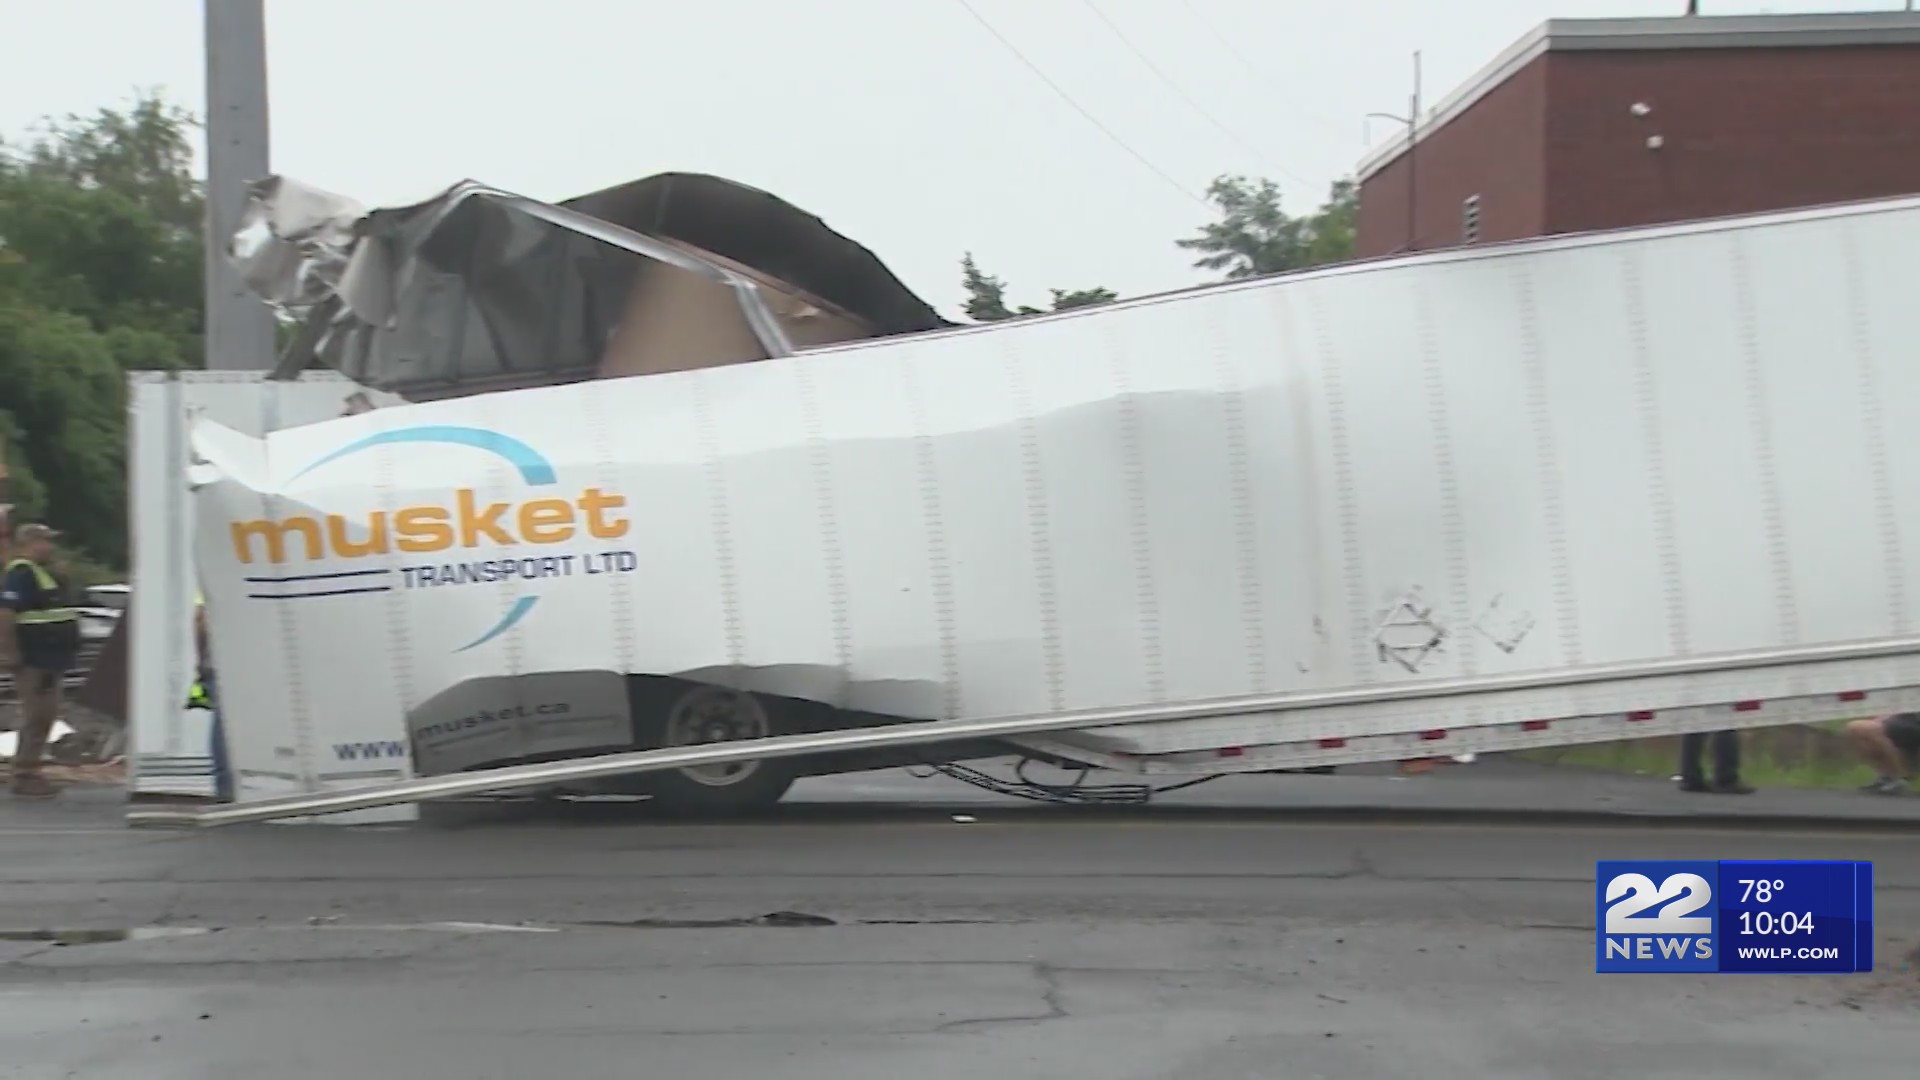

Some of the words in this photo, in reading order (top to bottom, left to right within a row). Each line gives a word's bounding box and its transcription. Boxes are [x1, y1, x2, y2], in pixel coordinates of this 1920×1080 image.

[230, 487, 630, 564] musket
[400, 555, 575, 589] TRANSPORT
[583, 551, 638, 574] LTD
